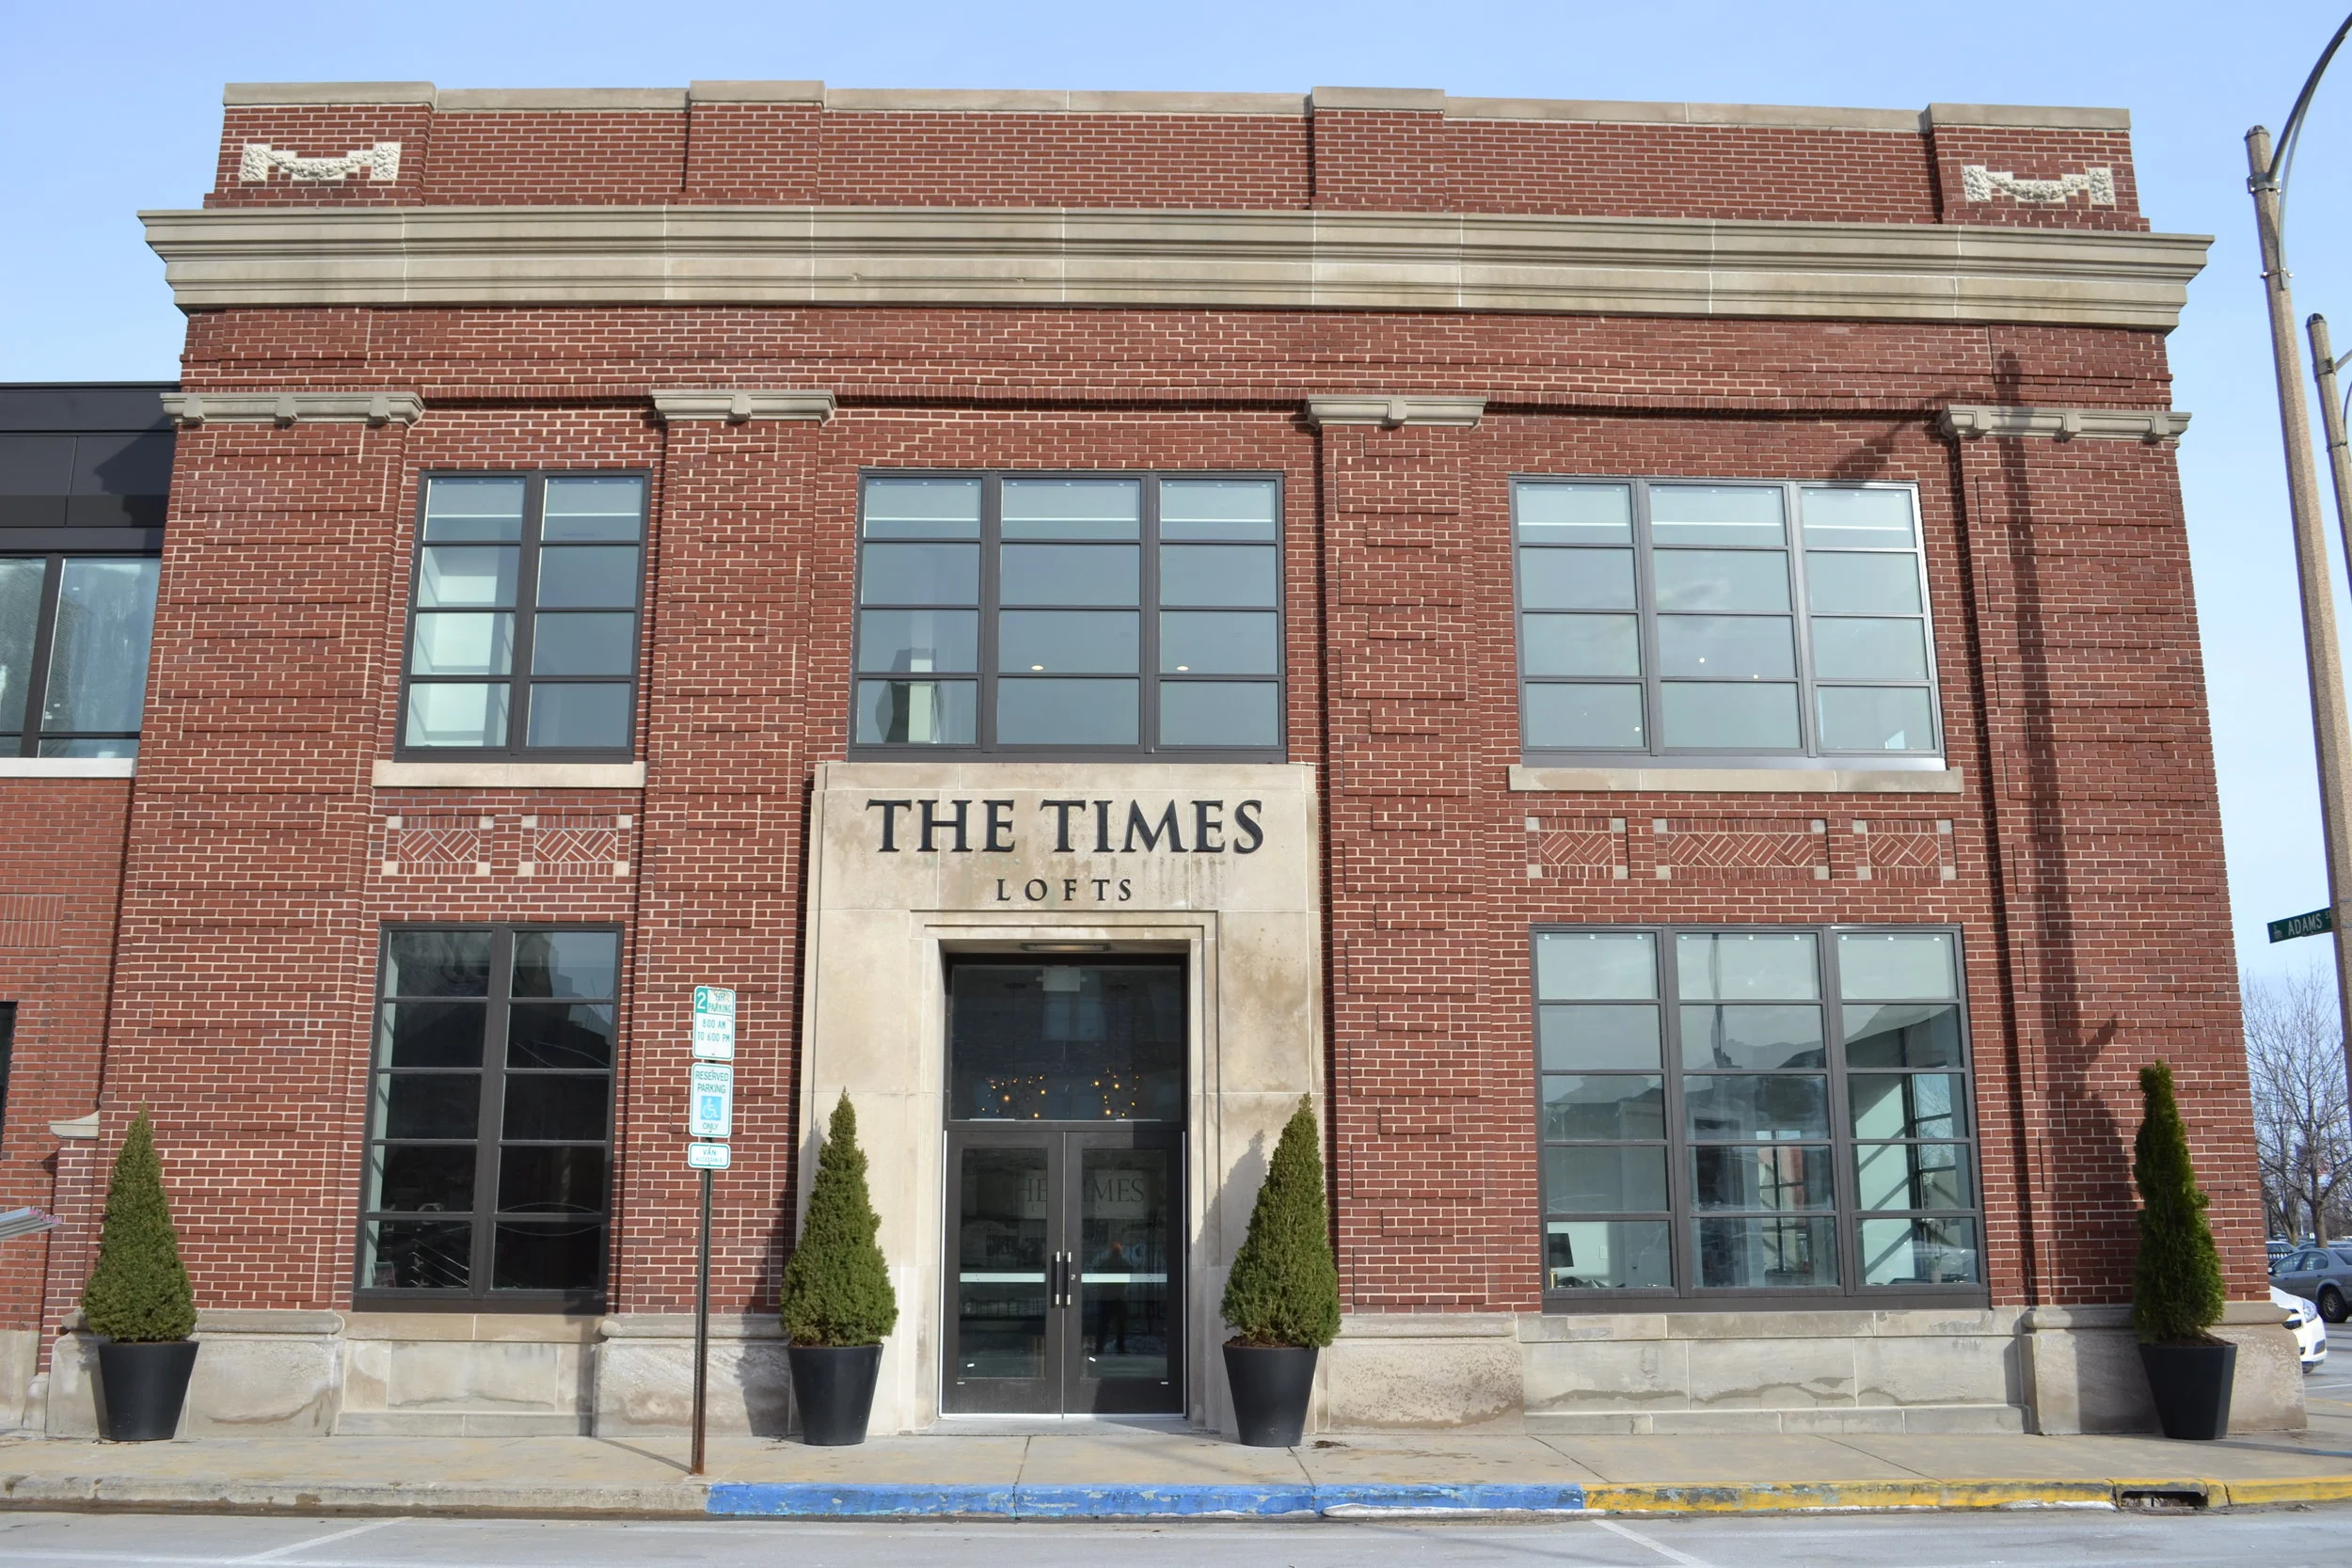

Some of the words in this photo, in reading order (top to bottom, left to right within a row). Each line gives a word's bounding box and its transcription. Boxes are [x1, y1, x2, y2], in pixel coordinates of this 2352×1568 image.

[866, 799, 1016, 853] THE
[1040, 799, 1264, 854] TIMES
[996, 879, 1132, 902] LOFTS
[2288, 913, 2323, 937] ADAMS
[697, 991, 707, 1009] 2
[707, 1003, 732, 1013] PARKING
[717, 1021, 726, 1029] AM
[697, 1031, 705, 1040] TO
[723, 1034, 730, 1043] PM
[695, 1070, 729, 1082] RESERVED
[697, 1083, 726, 1094] PARKING
